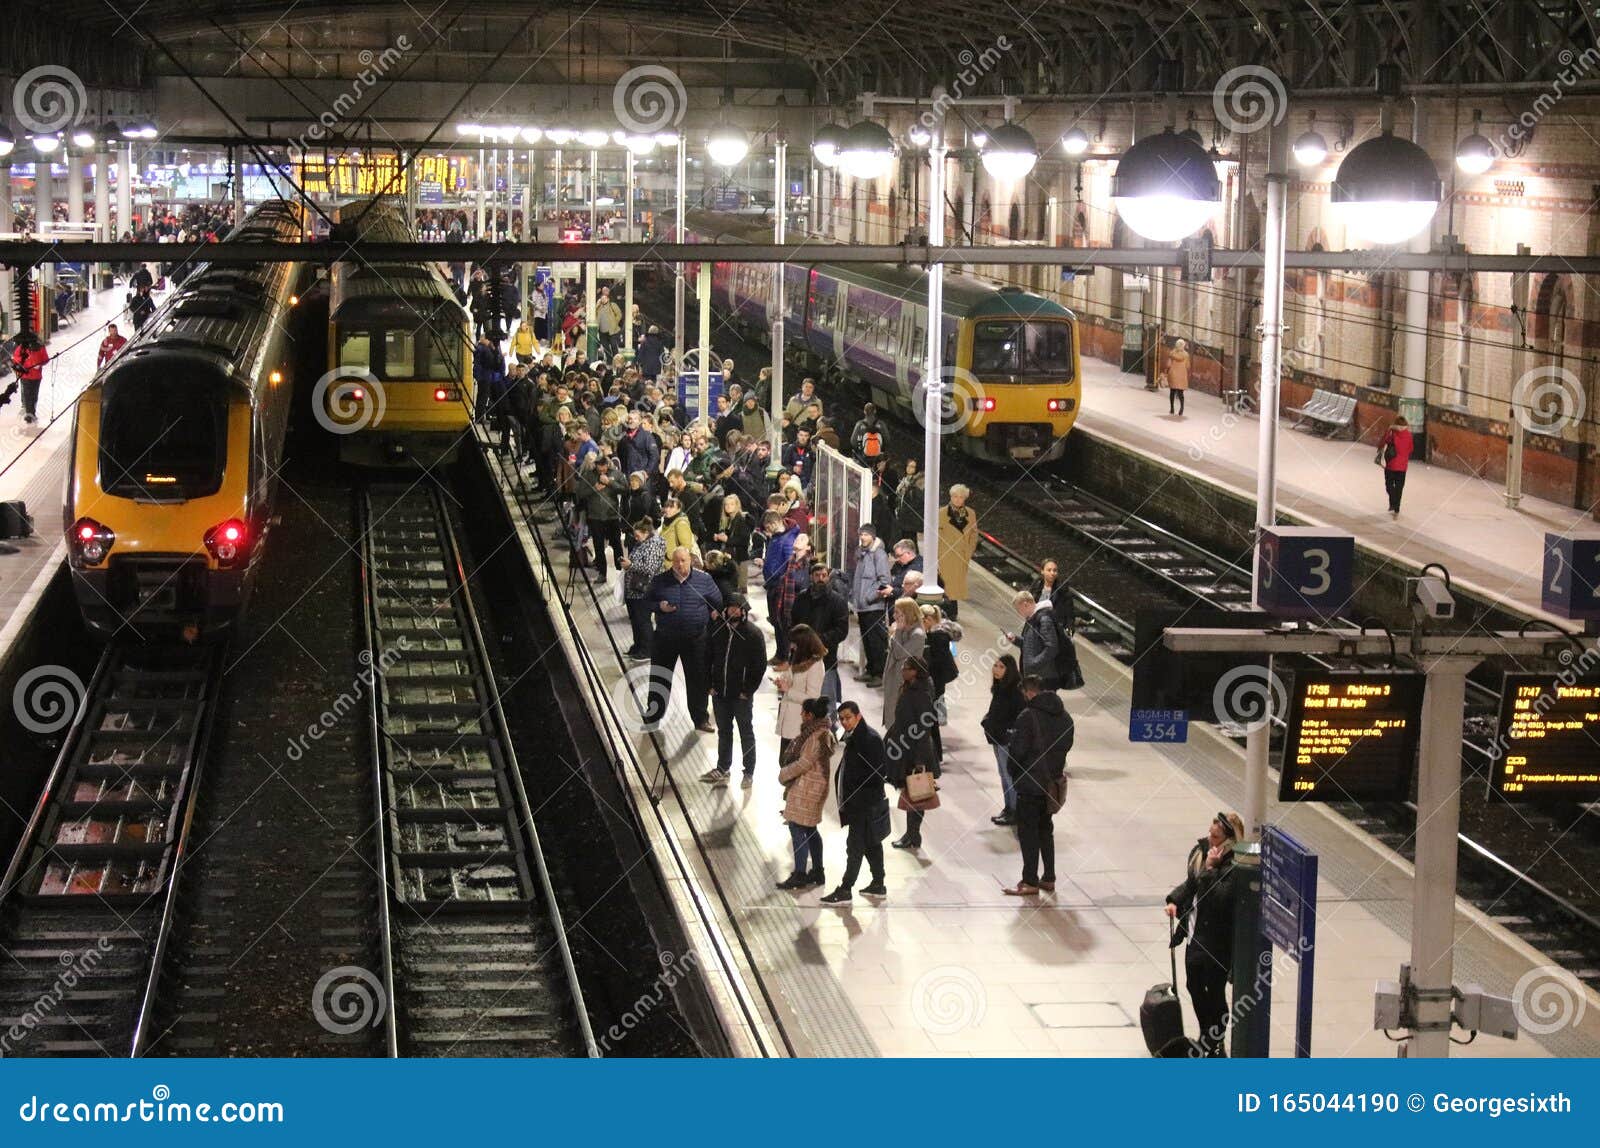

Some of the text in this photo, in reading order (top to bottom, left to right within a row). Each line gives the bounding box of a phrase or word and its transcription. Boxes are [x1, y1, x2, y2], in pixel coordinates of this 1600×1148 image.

[1300, 548, 1331, 596] 3
[1550, 546, 1563, 595] 2
[1346, 685, 1382, 695] Platform
[1383, 685, 1391, 695] 3
[1518, 687, 1600, 697] 17:47 Platform 2
[1142, 723, 1177, 740] 354
